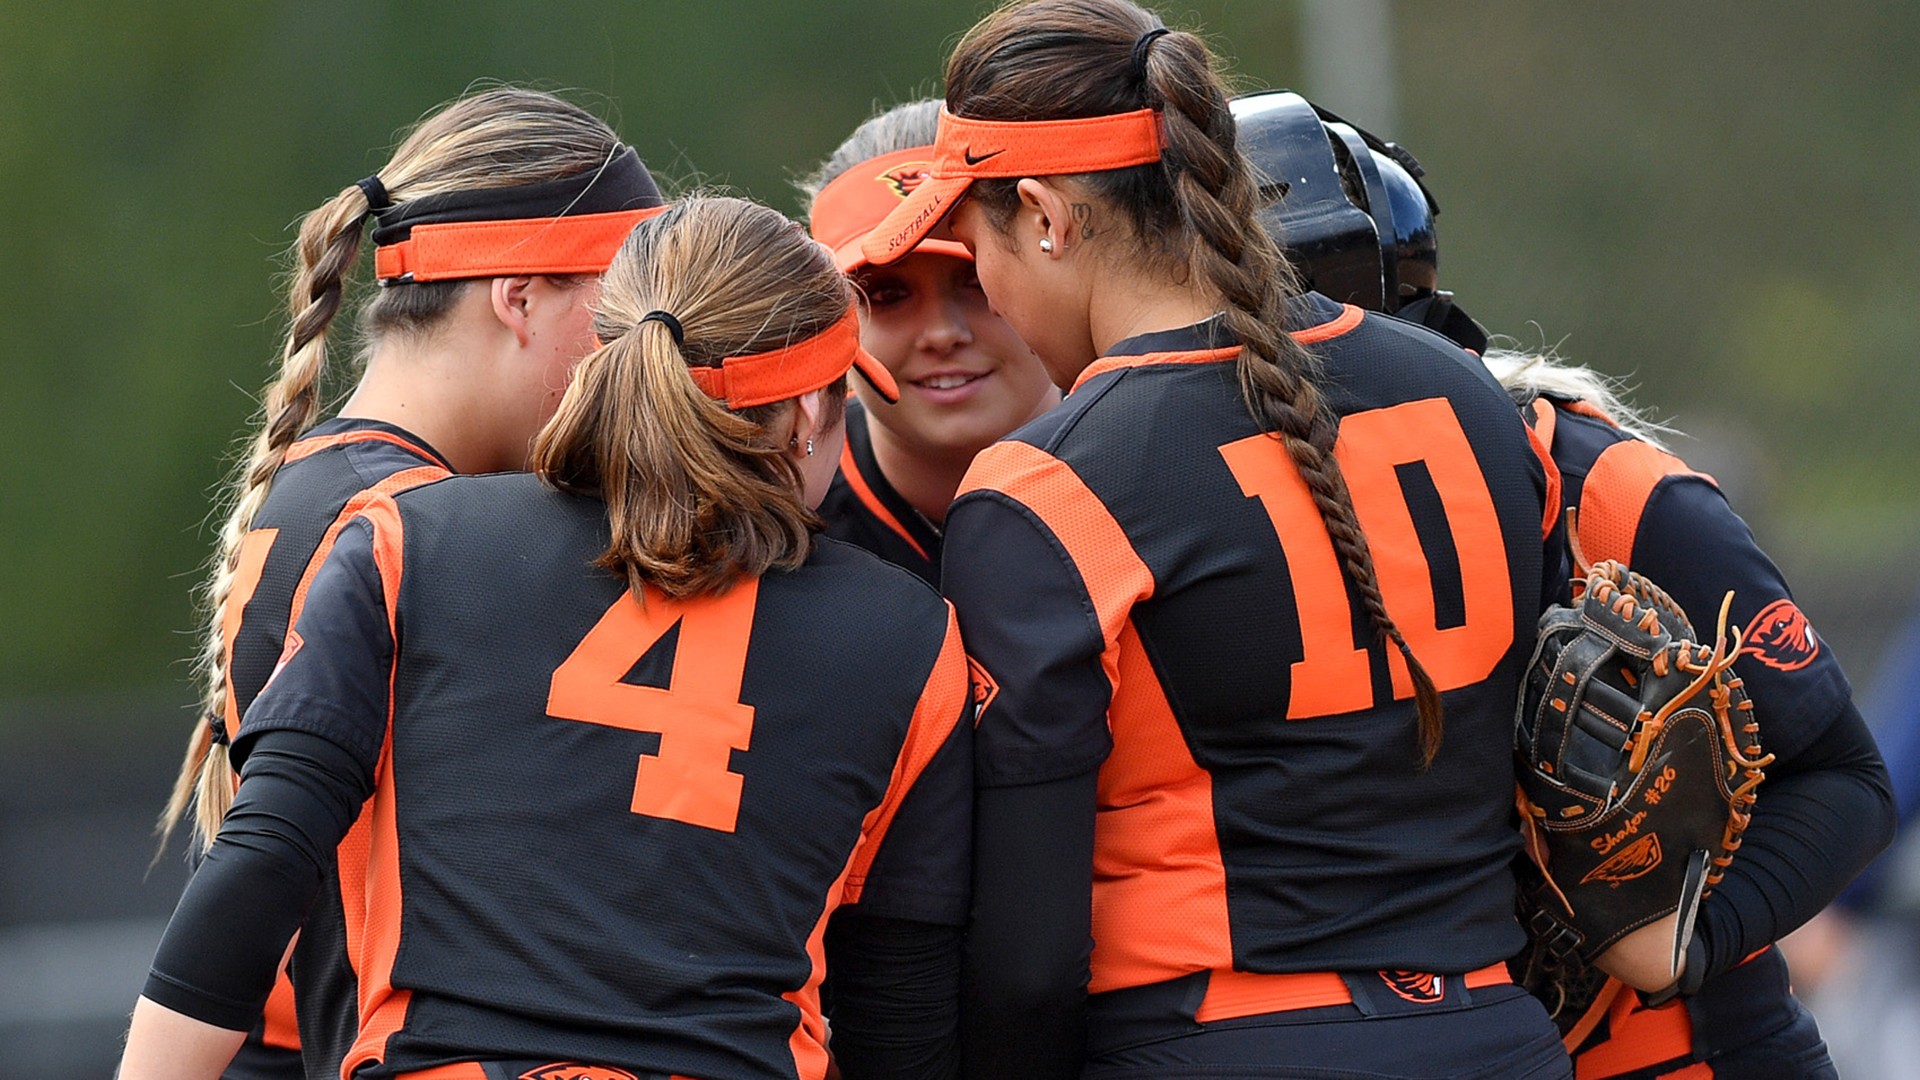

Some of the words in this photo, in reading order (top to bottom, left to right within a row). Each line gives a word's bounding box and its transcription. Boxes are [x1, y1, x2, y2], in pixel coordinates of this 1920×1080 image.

[888, 194, 942, 252] SOFTBALL
[1217, 397, 1514, 720] 10
[545, 576, 760, 833] 4
[1644, 764, 1677, 805] #26
